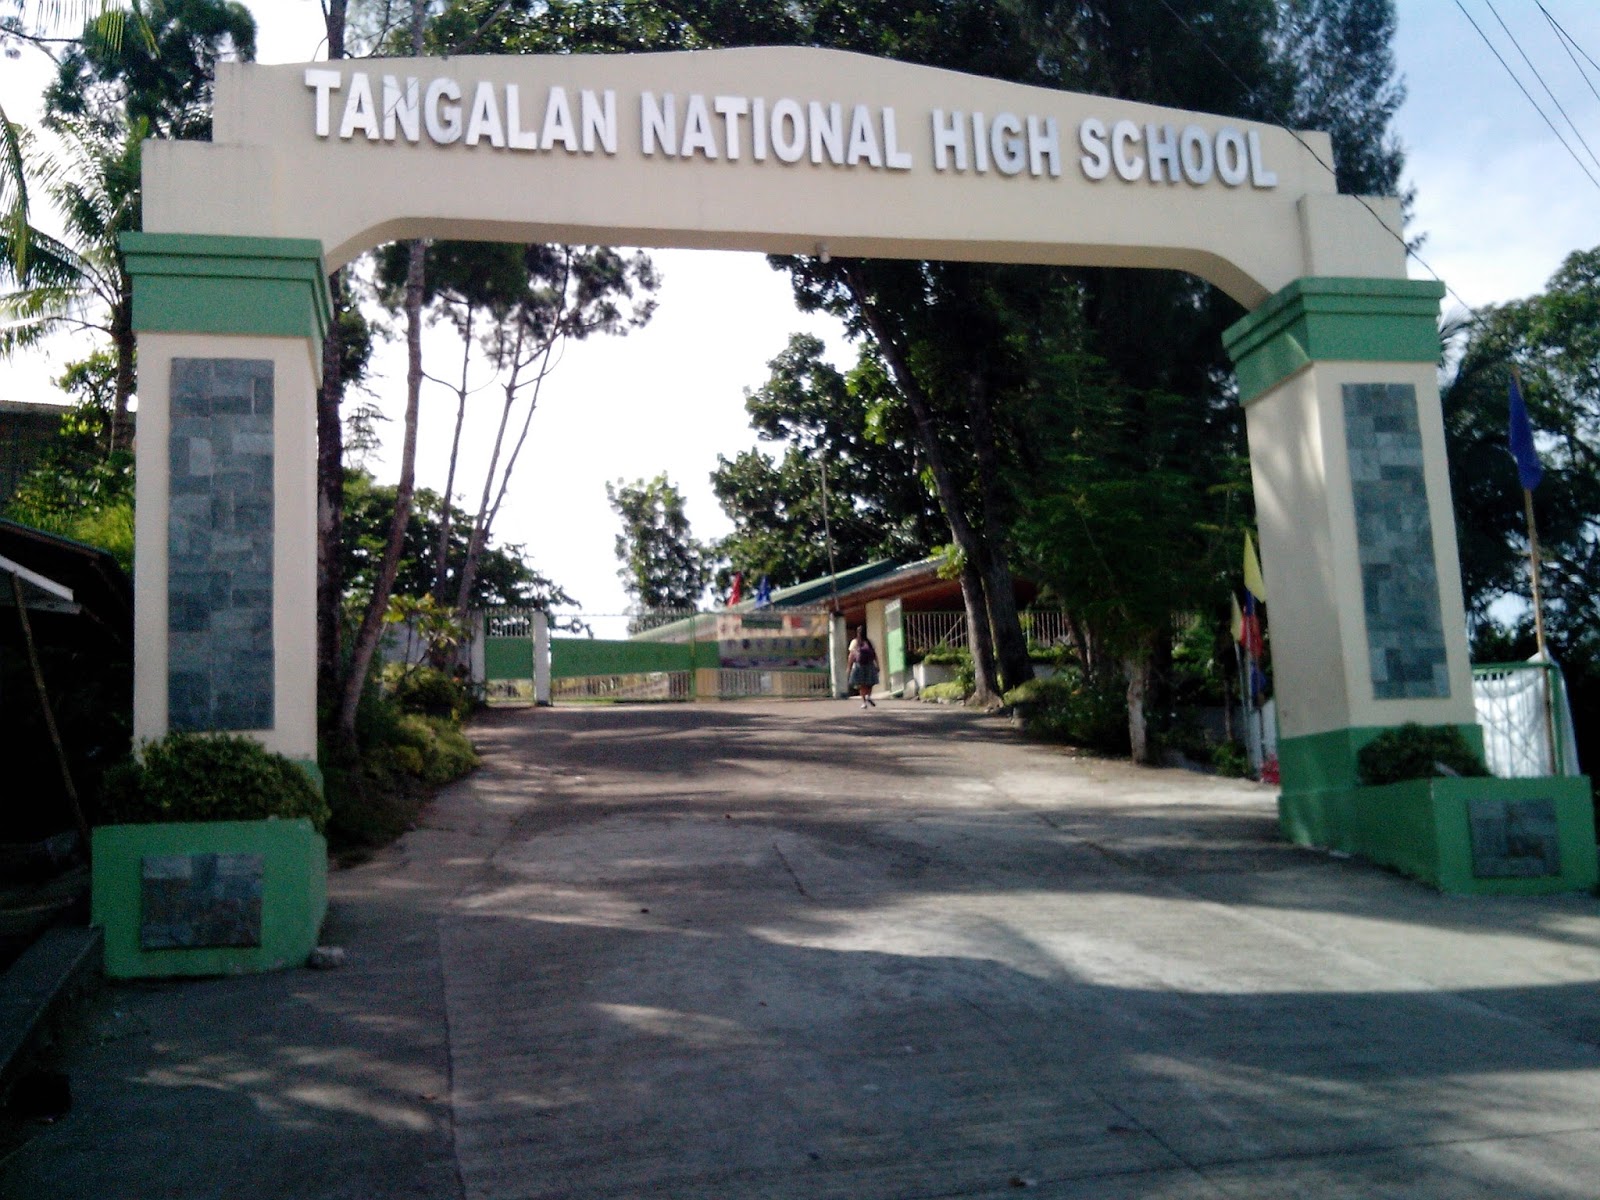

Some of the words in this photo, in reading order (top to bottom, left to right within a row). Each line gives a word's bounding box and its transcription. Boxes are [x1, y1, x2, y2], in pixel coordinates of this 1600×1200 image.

[304, 69, 617, 154] TANGALAN
[641, 91, 912, 170] NATIONAL
[932, 108, 1062, 178] HIGH
[1079, 117, 1278, 188] SCHOOL
